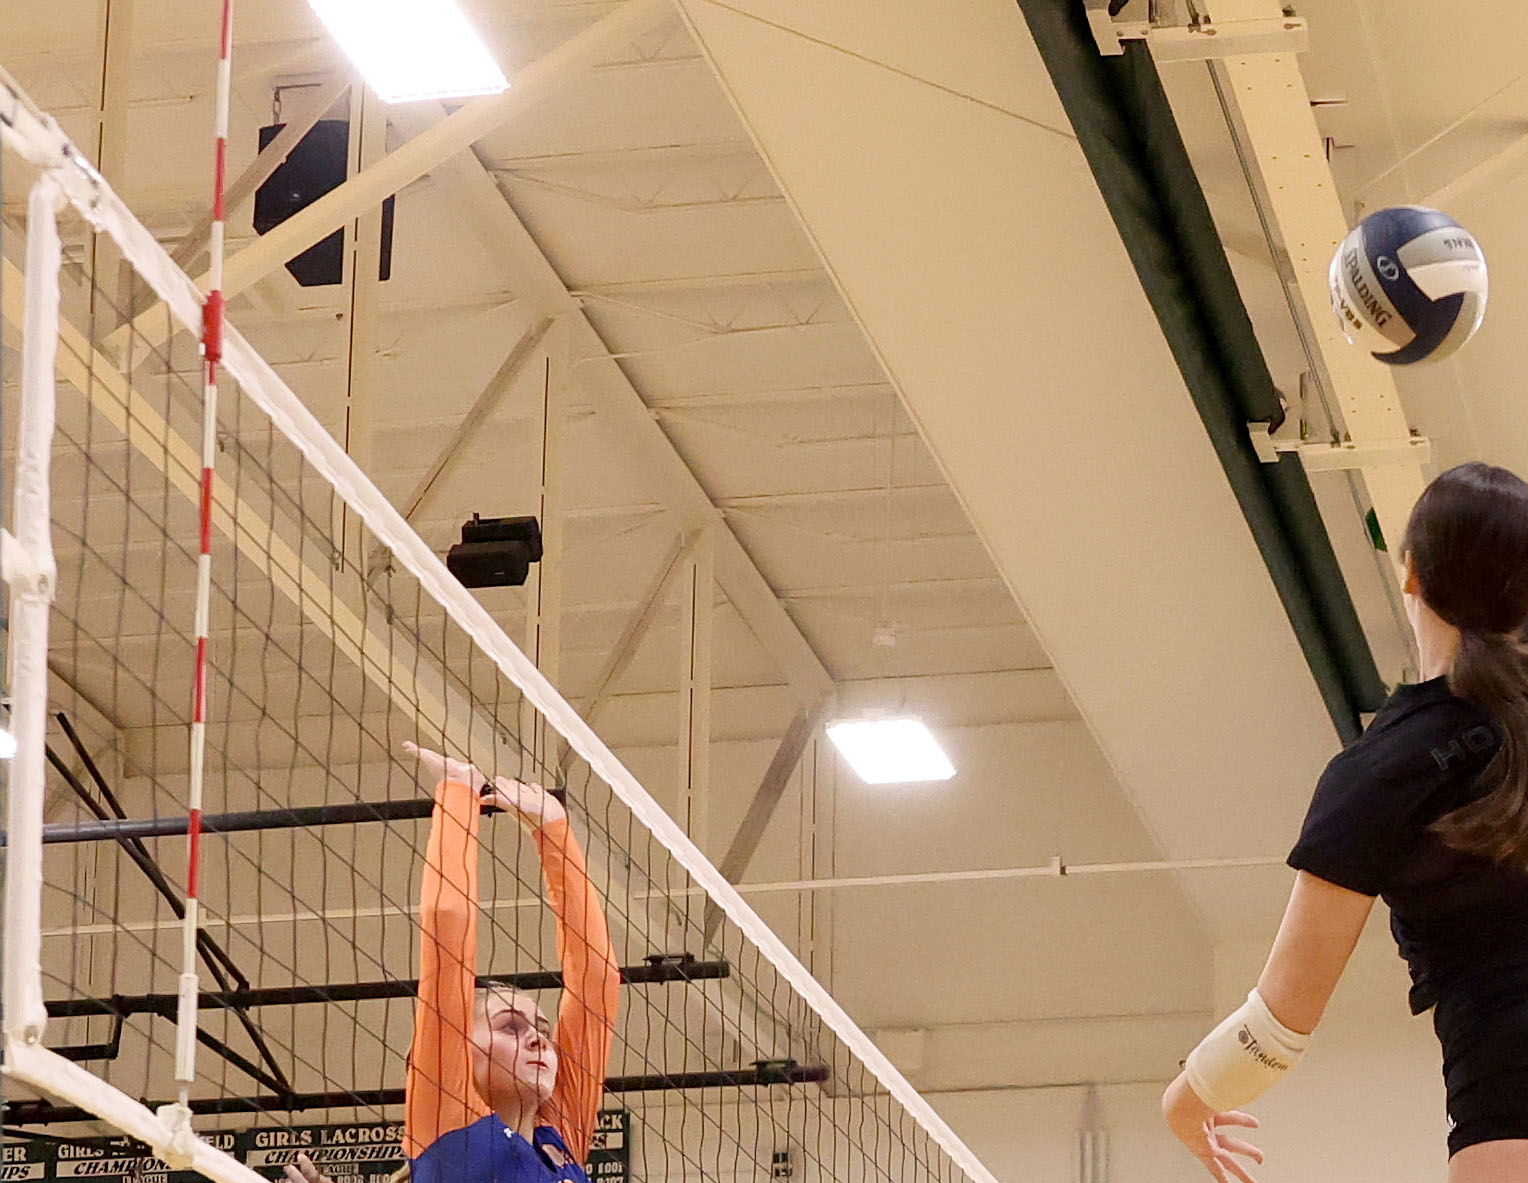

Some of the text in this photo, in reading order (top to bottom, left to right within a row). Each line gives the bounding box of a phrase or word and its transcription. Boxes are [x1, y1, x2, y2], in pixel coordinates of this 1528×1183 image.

[1344, 248, 1393, 328] SPALDING
[255, 1126, 405, 1148] GIRLS LACROSS
